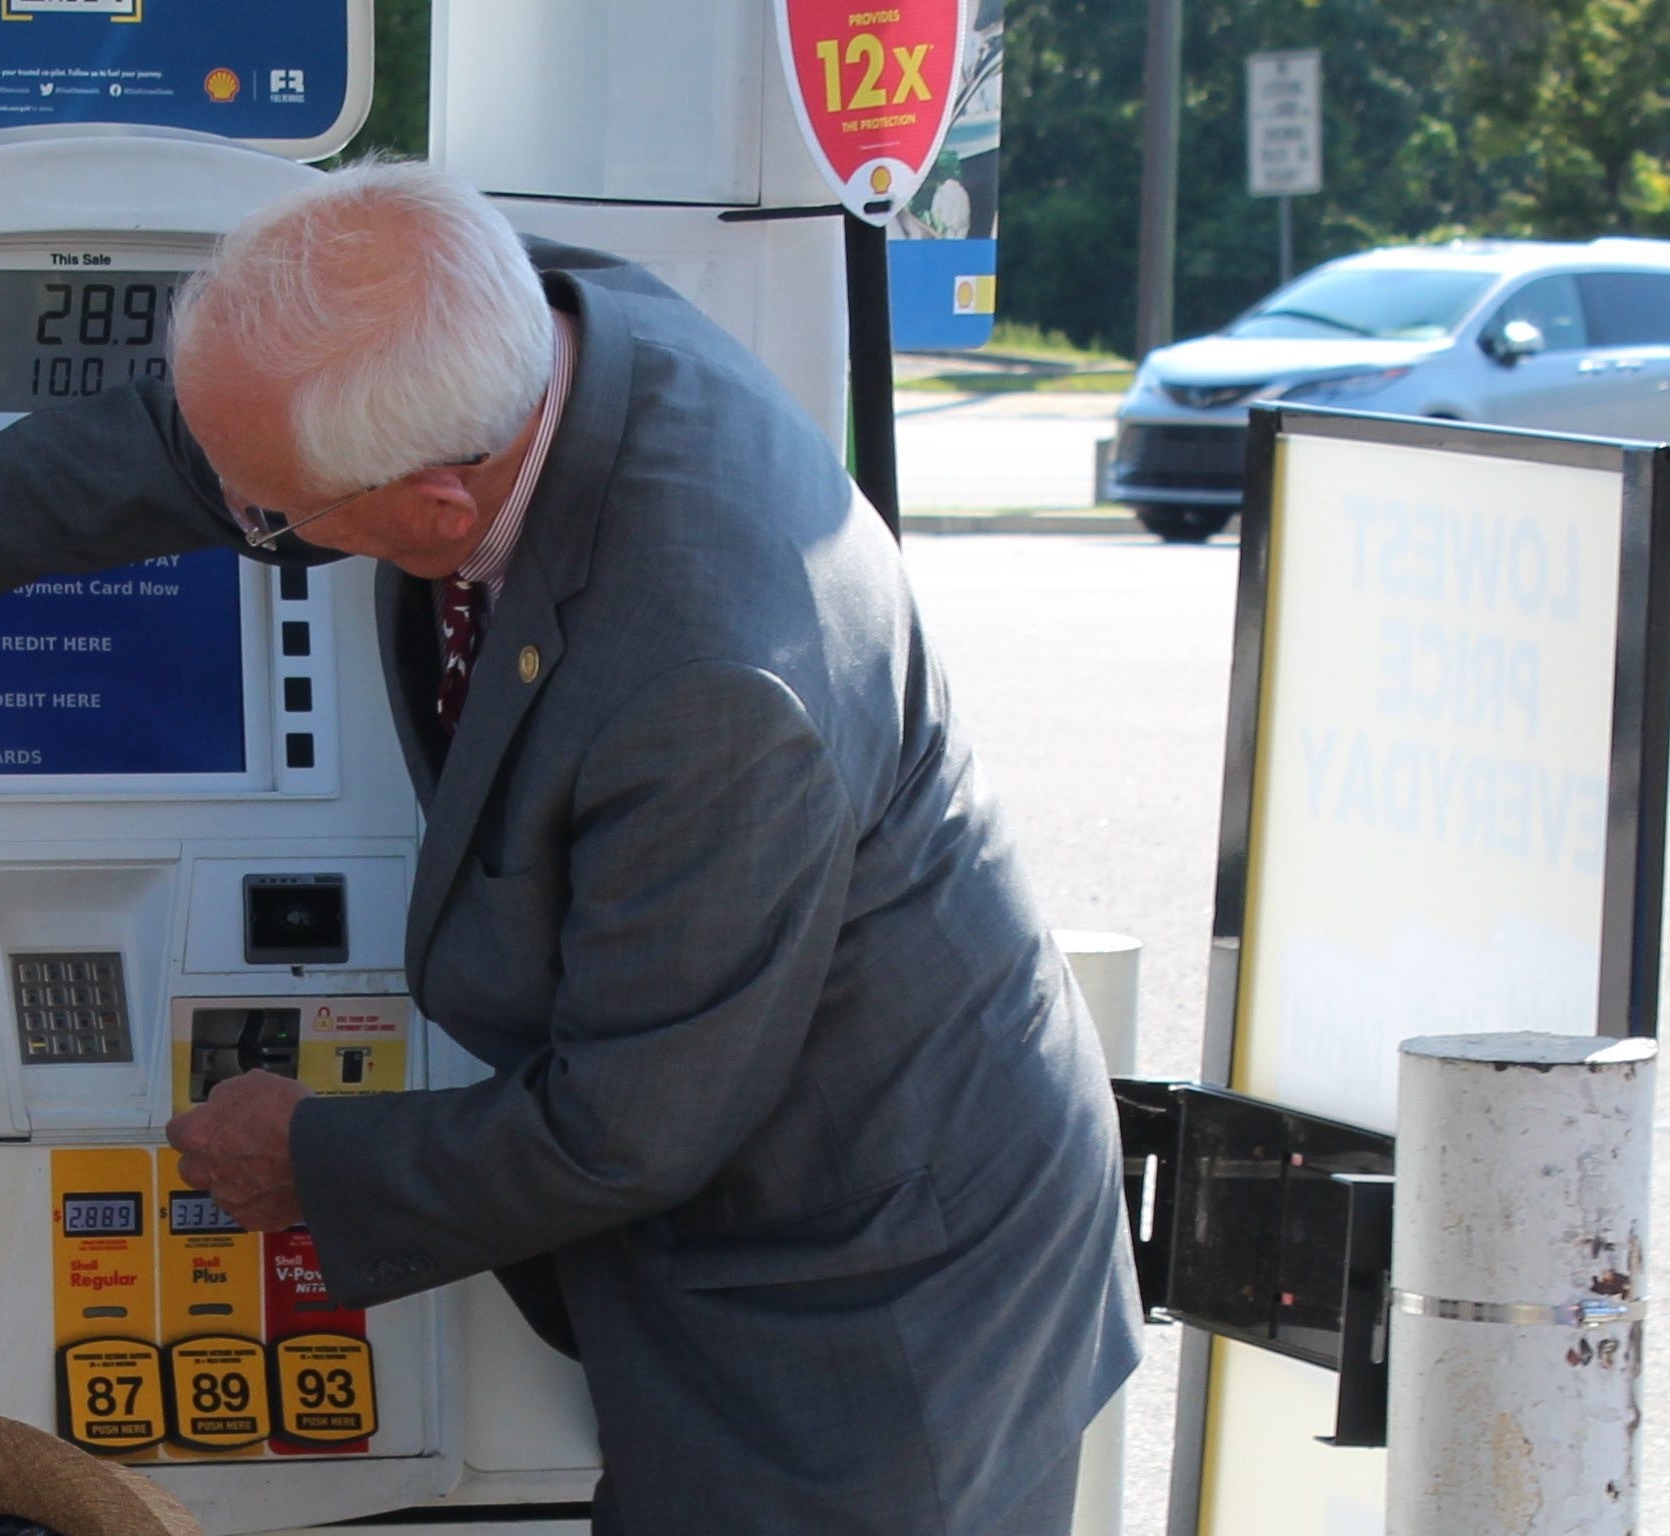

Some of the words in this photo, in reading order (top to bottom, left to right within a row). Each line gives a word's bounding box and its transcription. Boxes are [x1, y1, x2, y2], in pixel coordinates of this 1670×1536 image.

[848, 9, 901, 26] PROVIDES
[842, 121, 858, 132] THE
[860, 114, 917, 130] PROTECTION
[51, 253, 79, 265] This
[83, 253, 112, 265] Sale
[36, 284, 174, 345] 28.9
[13, 581, 84, 597] ayment
[89, 581, 133, 595] Card
[139, 581, 180, 596] Now
[63, 637, 112, 651] HERE
[52, 694, 101, 708] HERE
[70, 1206, 131, 1228] 2.889
[71, 1259, 99, 1271] Shell
[193, 1256, 221, 1268] Shell
[275, 1255, 302, 1266] Shell
[71, 1270, 138, 1291] Regular
[193, 1268, 227, 1283] Plus
[192, 1372, 249, 1412] 89
[297, 1368, 355, 1408] 93
[87, 1376, 143, 1416] 87
[197, 1422, 223, 1430] PUSH
[226, 1421, 250, 1429] HERE
[303, 1417, 329, 1426] PUSH
[92, 1425, 118, 1435] PUSH
[121, 1424, 147, 1433] HERE
